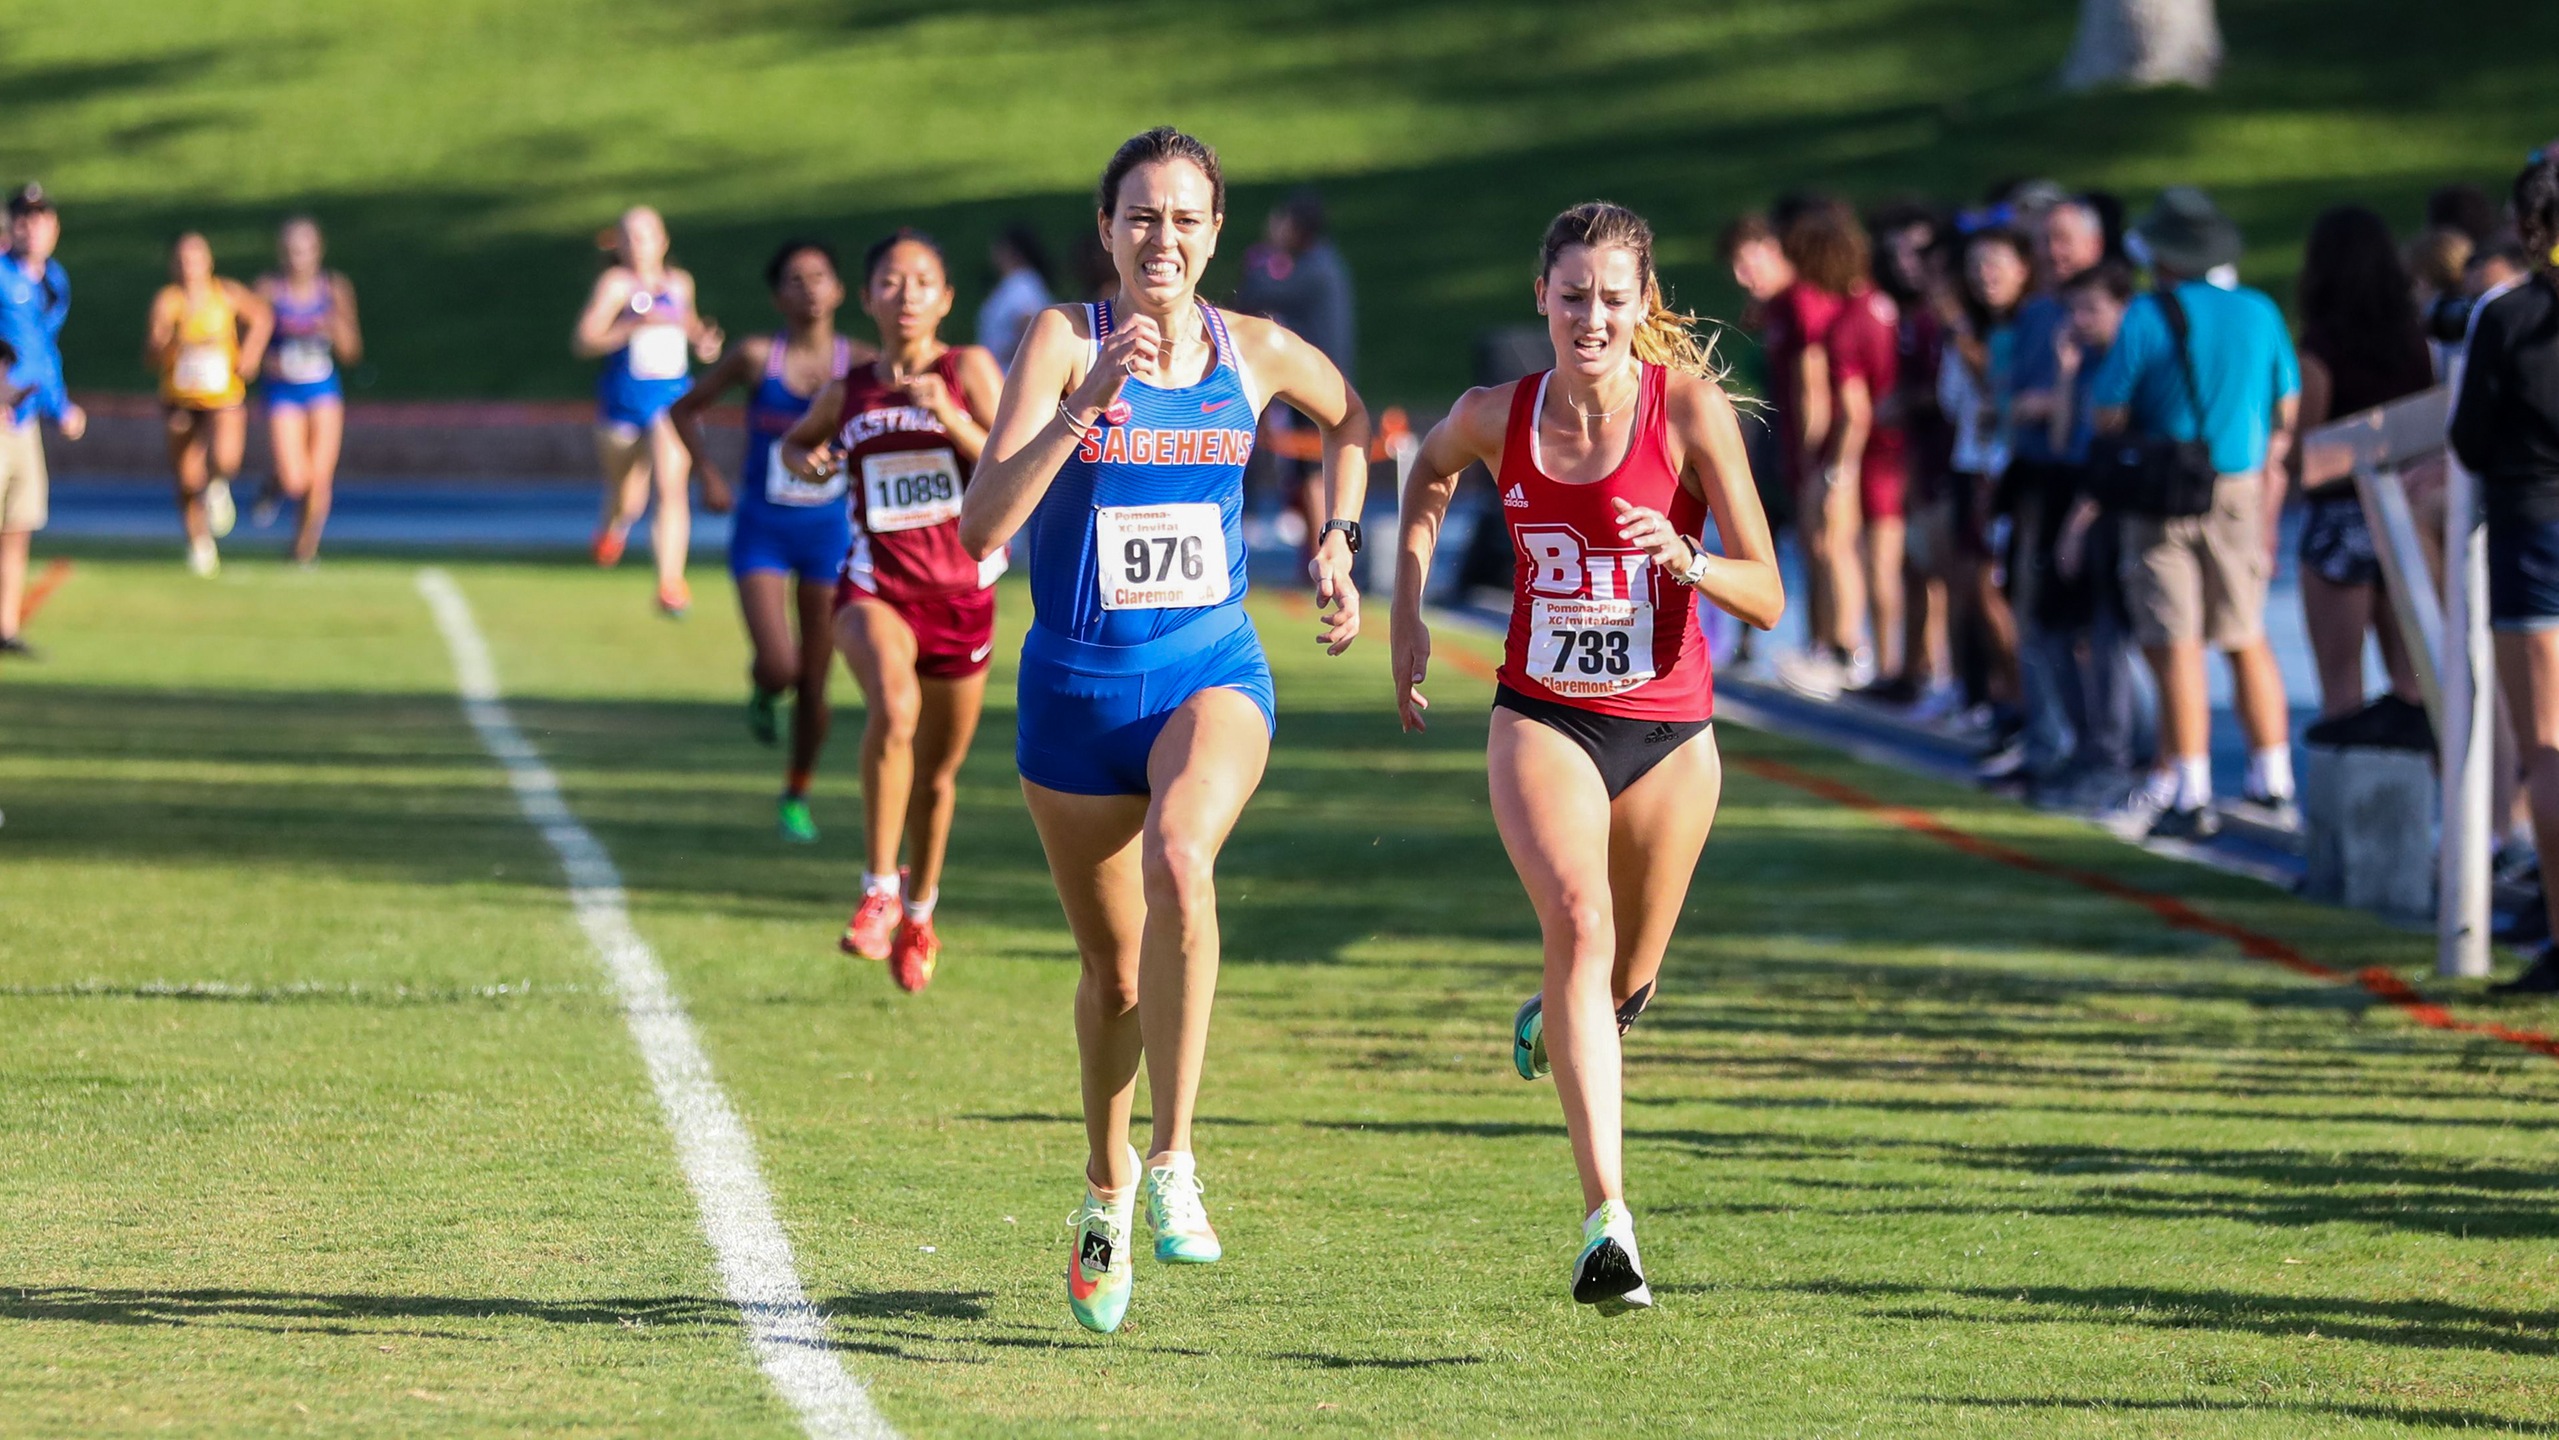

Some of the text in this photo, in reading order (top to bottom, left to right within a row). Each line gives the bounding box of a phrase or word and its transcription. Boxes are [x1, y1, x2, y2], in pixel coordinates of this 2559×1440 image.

[1079, 426, 1253, 467] SAGEHENS
[879, 473, 952, 508] 1089
[1503, 497, 1529, 508] adidas
[1119, 524, 1133, 533] XC
[1124, 536, 1203, 584] 976
[1115, 588, 1184, 605] Claremon
[1548, 616, 1635, 627] XC Invitational
[1551, 630, 1630, 675] 733
